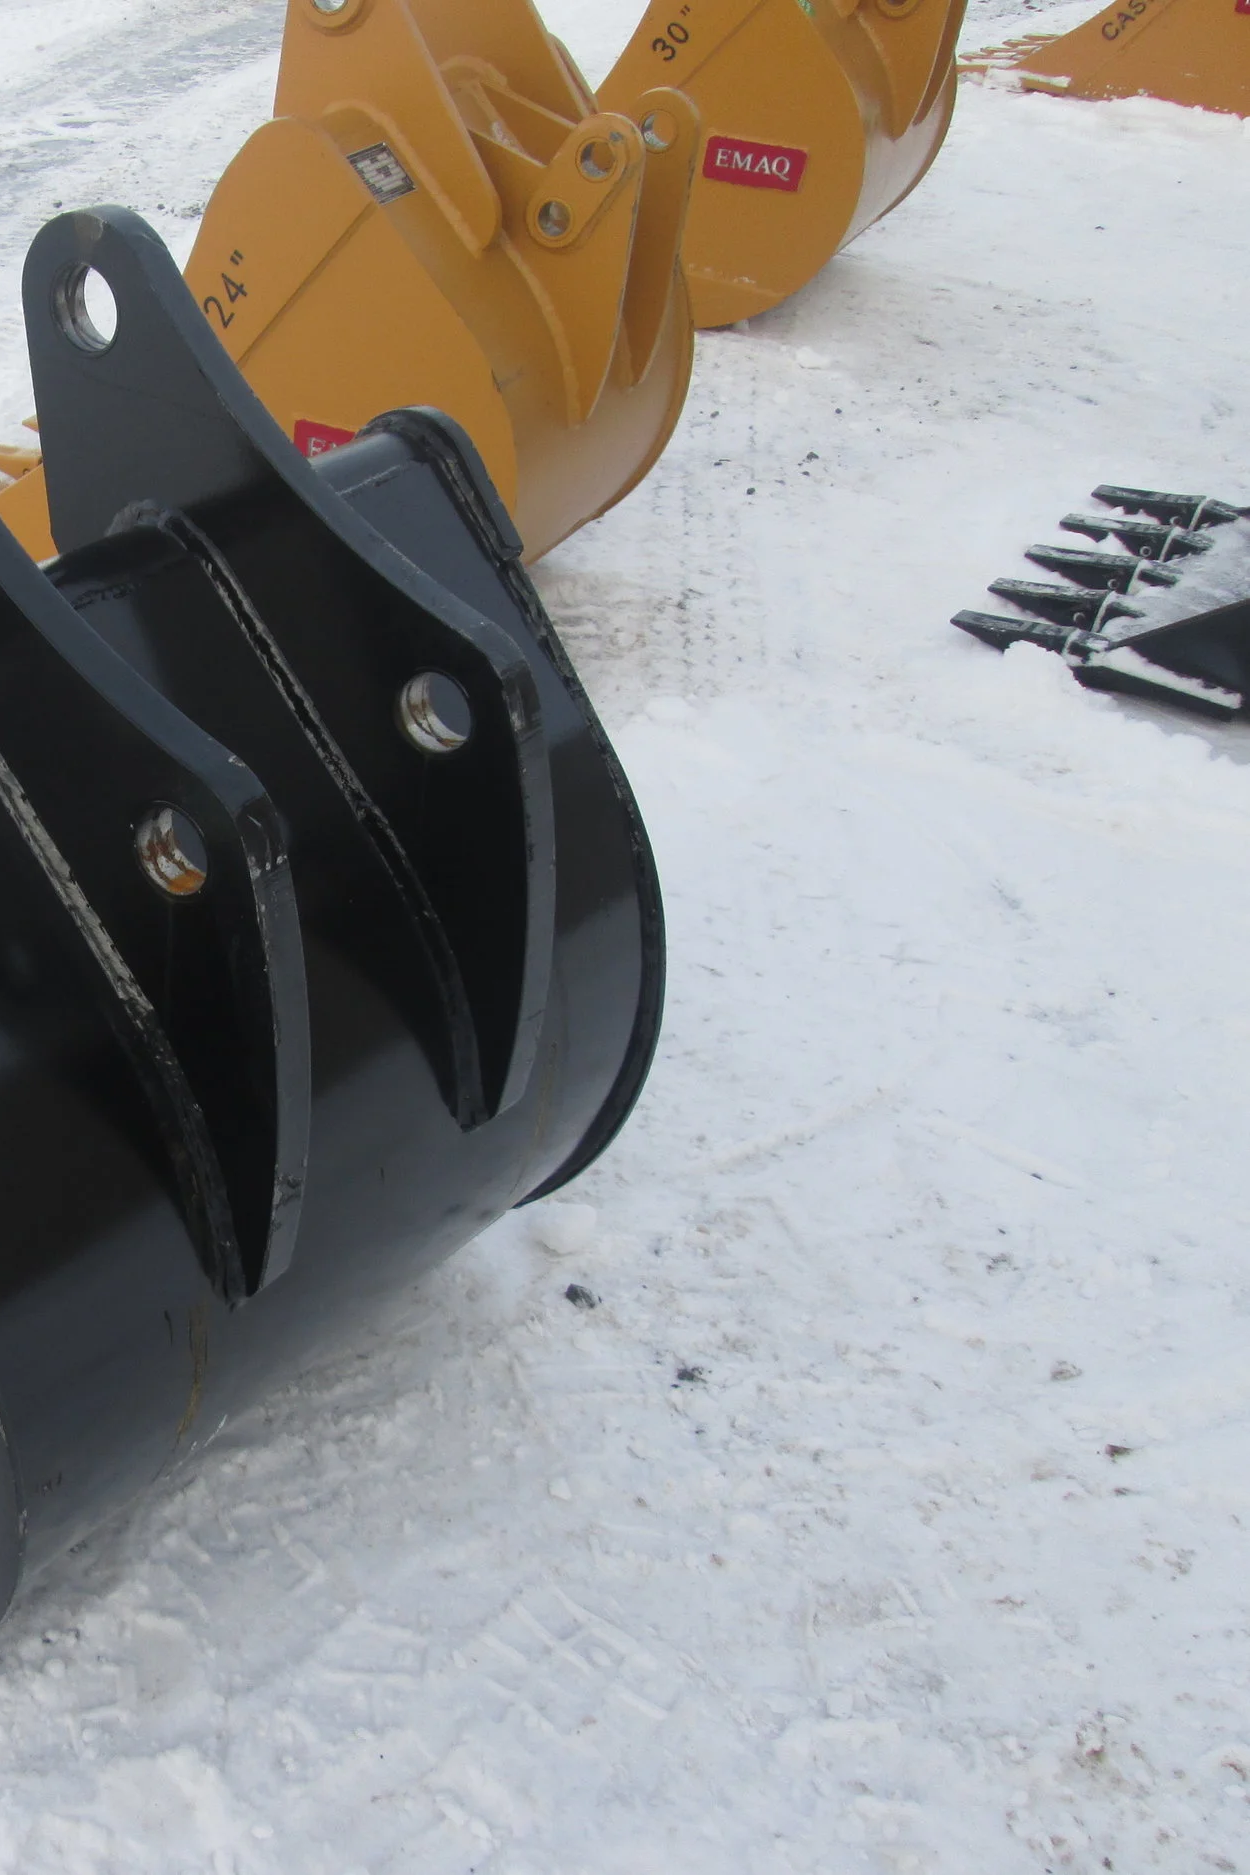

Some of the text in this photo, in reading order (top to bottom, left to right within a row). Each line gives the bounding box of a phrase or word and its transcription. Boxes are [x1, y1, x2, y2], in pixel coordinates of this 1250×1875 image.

[652, 5, 691, 62] 30"
[1101, 0, 1159, 41] CAS
[715, 148, 790, 182] EMAQ
[203, 249, 248, 329] 24"
